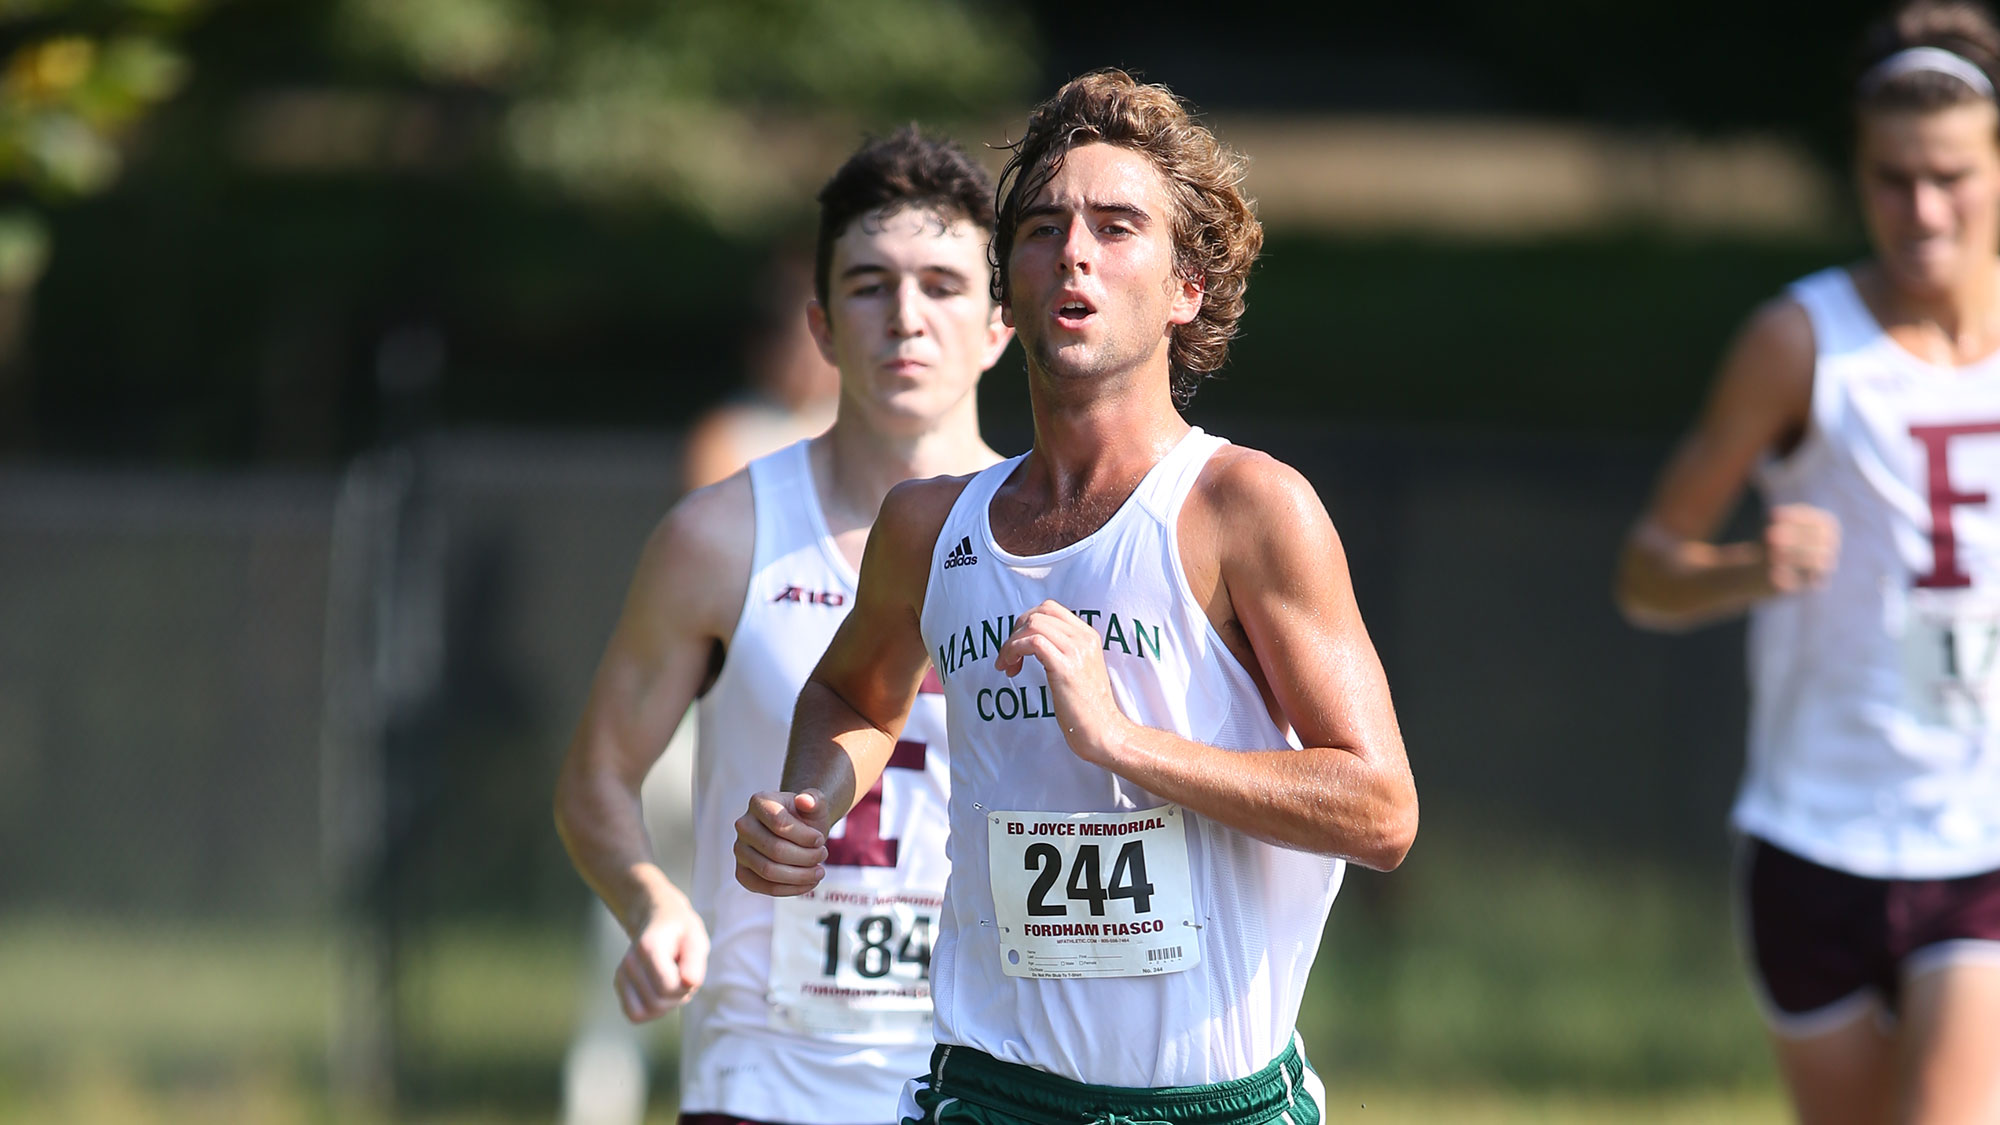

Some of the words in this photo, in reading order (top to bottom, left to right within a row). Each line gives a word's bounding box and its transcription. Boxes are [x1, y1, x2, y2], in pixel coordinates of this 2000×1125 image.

[1909, 421, 2000, 588] F
[944, 554, 978, 569] adidas
[1007, 822, 1024, 835] ED
[1028, 822, 1075, 836] JOYCE
[1079, 817, 1165, 836] MEMORIAL
[1024, 840, 1155, 916] 244
[818, 912, 931, 979] 184
[1024, 923, 1100, 937] FORDHAM
[1103, 920, 1164, 936] FIASCO
